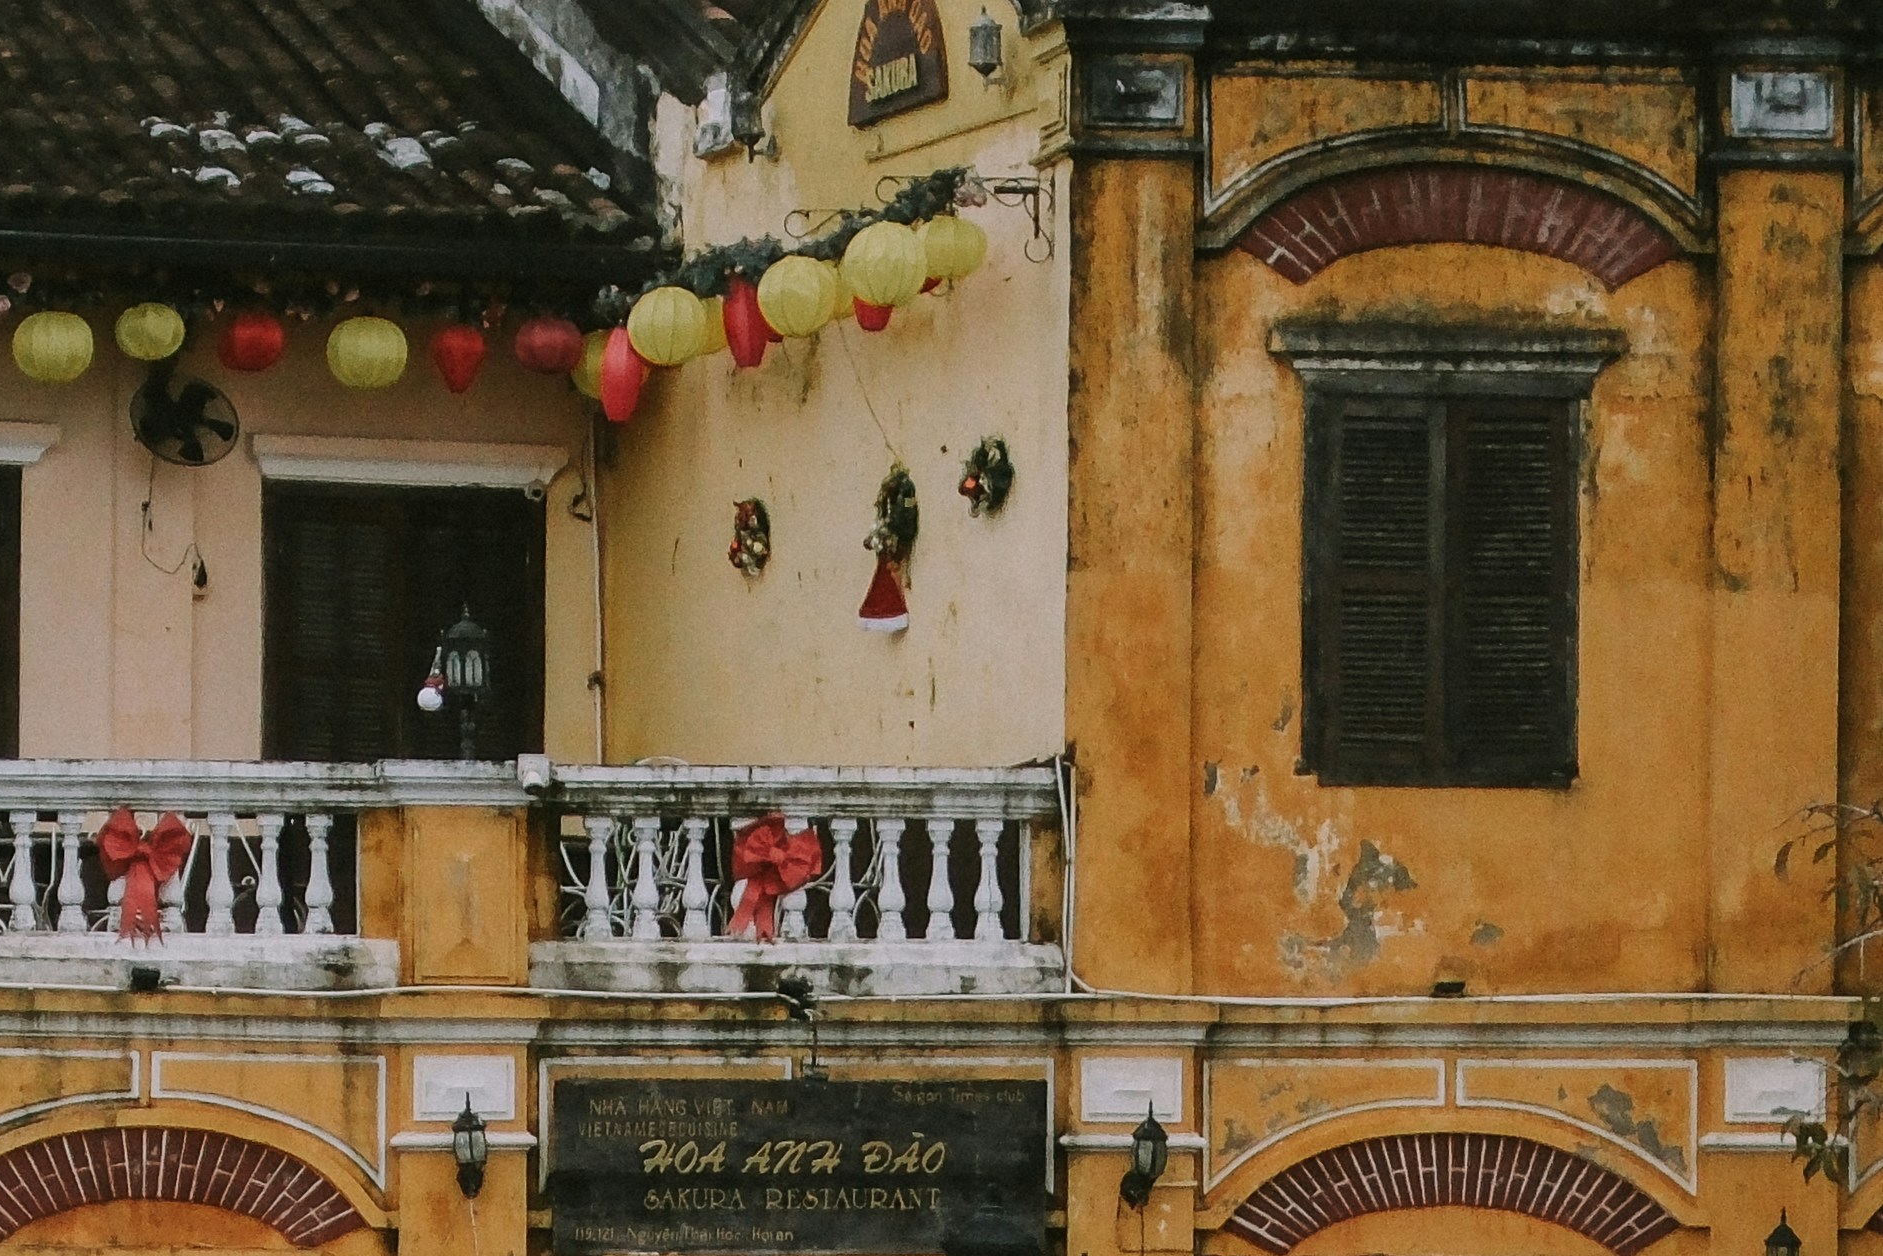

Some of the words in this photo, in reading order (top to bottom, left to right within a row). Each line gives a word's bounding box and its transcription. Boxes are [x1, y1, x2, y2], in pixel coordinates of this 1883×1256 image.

[865, 53, 918, 103] SAKURA
[751, 1099, 788, 1116] NAM
[639, 1139, 727, 1174] HOA
[741, 1139, 843, 1174] ANH
[861, 1131, 946, 1174] ĐÀO
[643, 1187, 747, 1211] SAKURA
[765, 1187, 942, 1211] RESTAURANT
